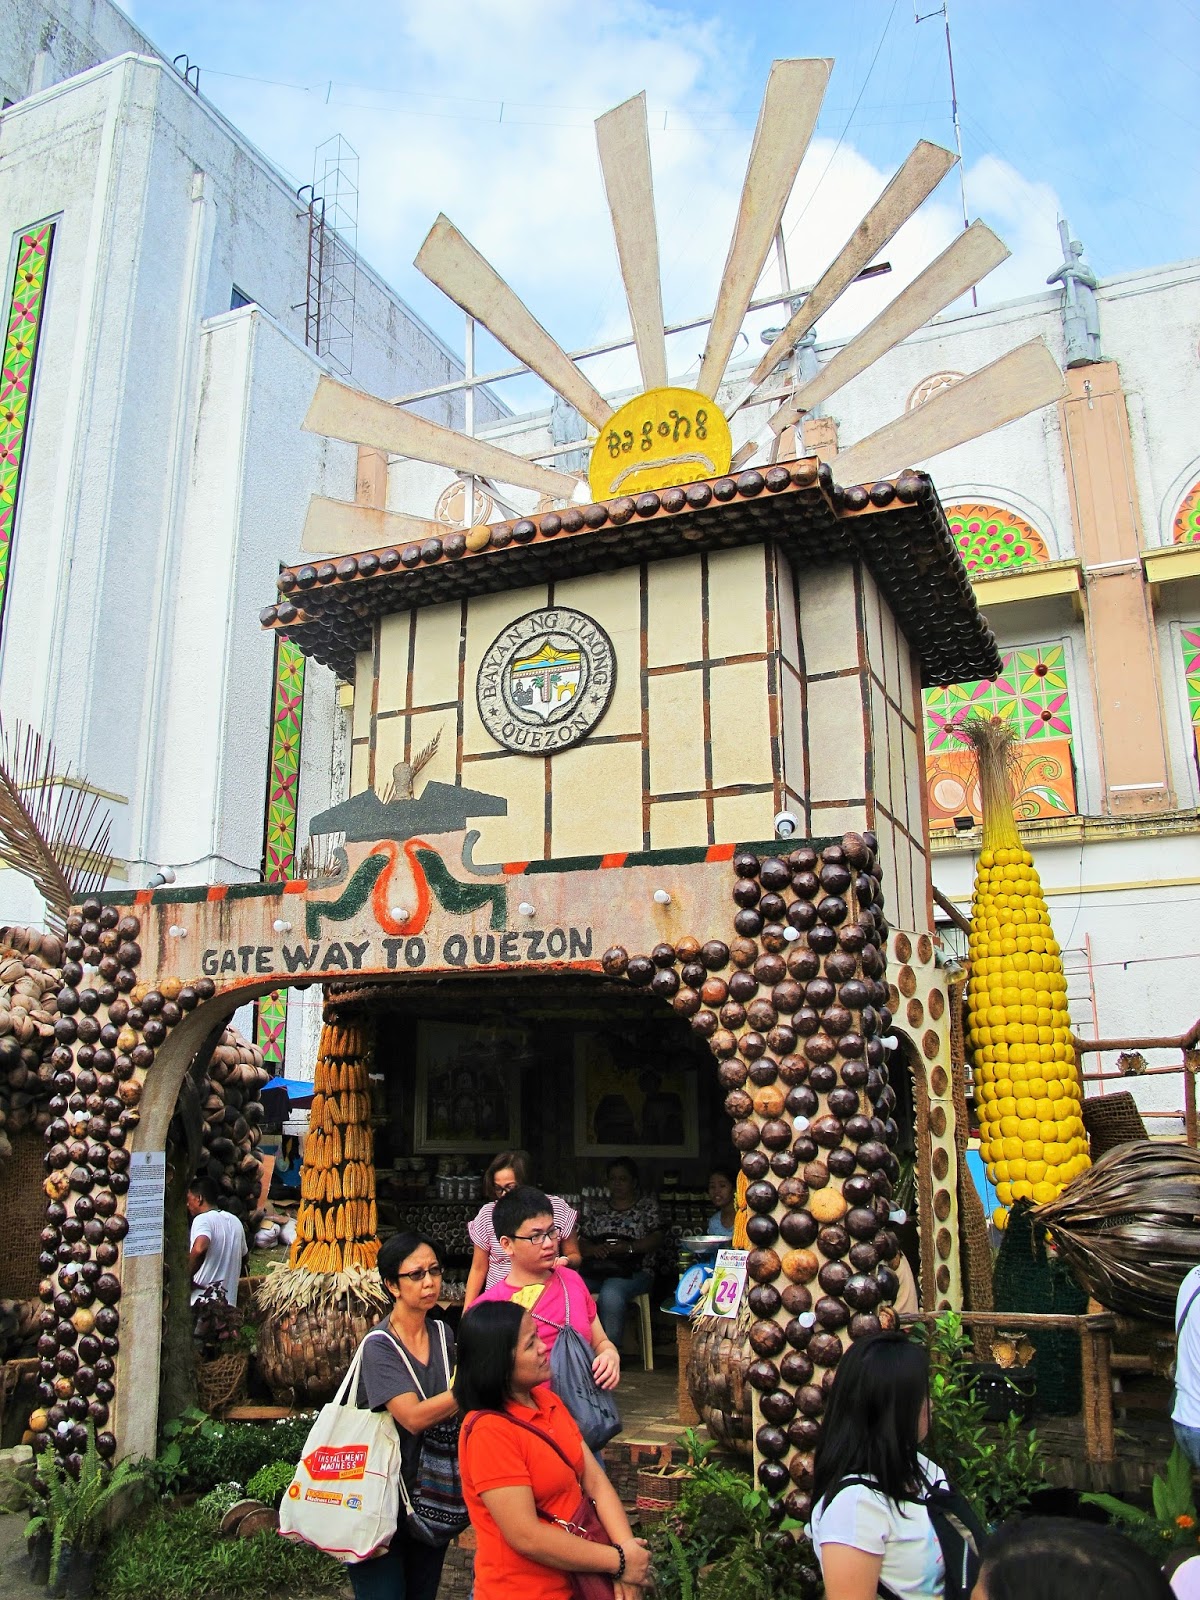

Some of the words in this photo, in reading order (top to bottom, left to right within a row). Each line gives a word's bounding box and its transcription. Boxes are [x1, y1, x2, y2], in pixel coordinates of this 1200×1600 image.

[482, 626, 525, 703] BAYAN
[528, 612, 559, 633] NG
[565, 615, 609, 686] TIAONG
[502, 711, 591, 748] QUEZON
[381, 936, 427, 970] TO
[442, 926, 593, 969] QUEZON
[716, 1281, 737, 1303] 24
[317, 1453, 364, 1463] INSTALLMENT
[319, 1461, 357, 1471] MADNESS
